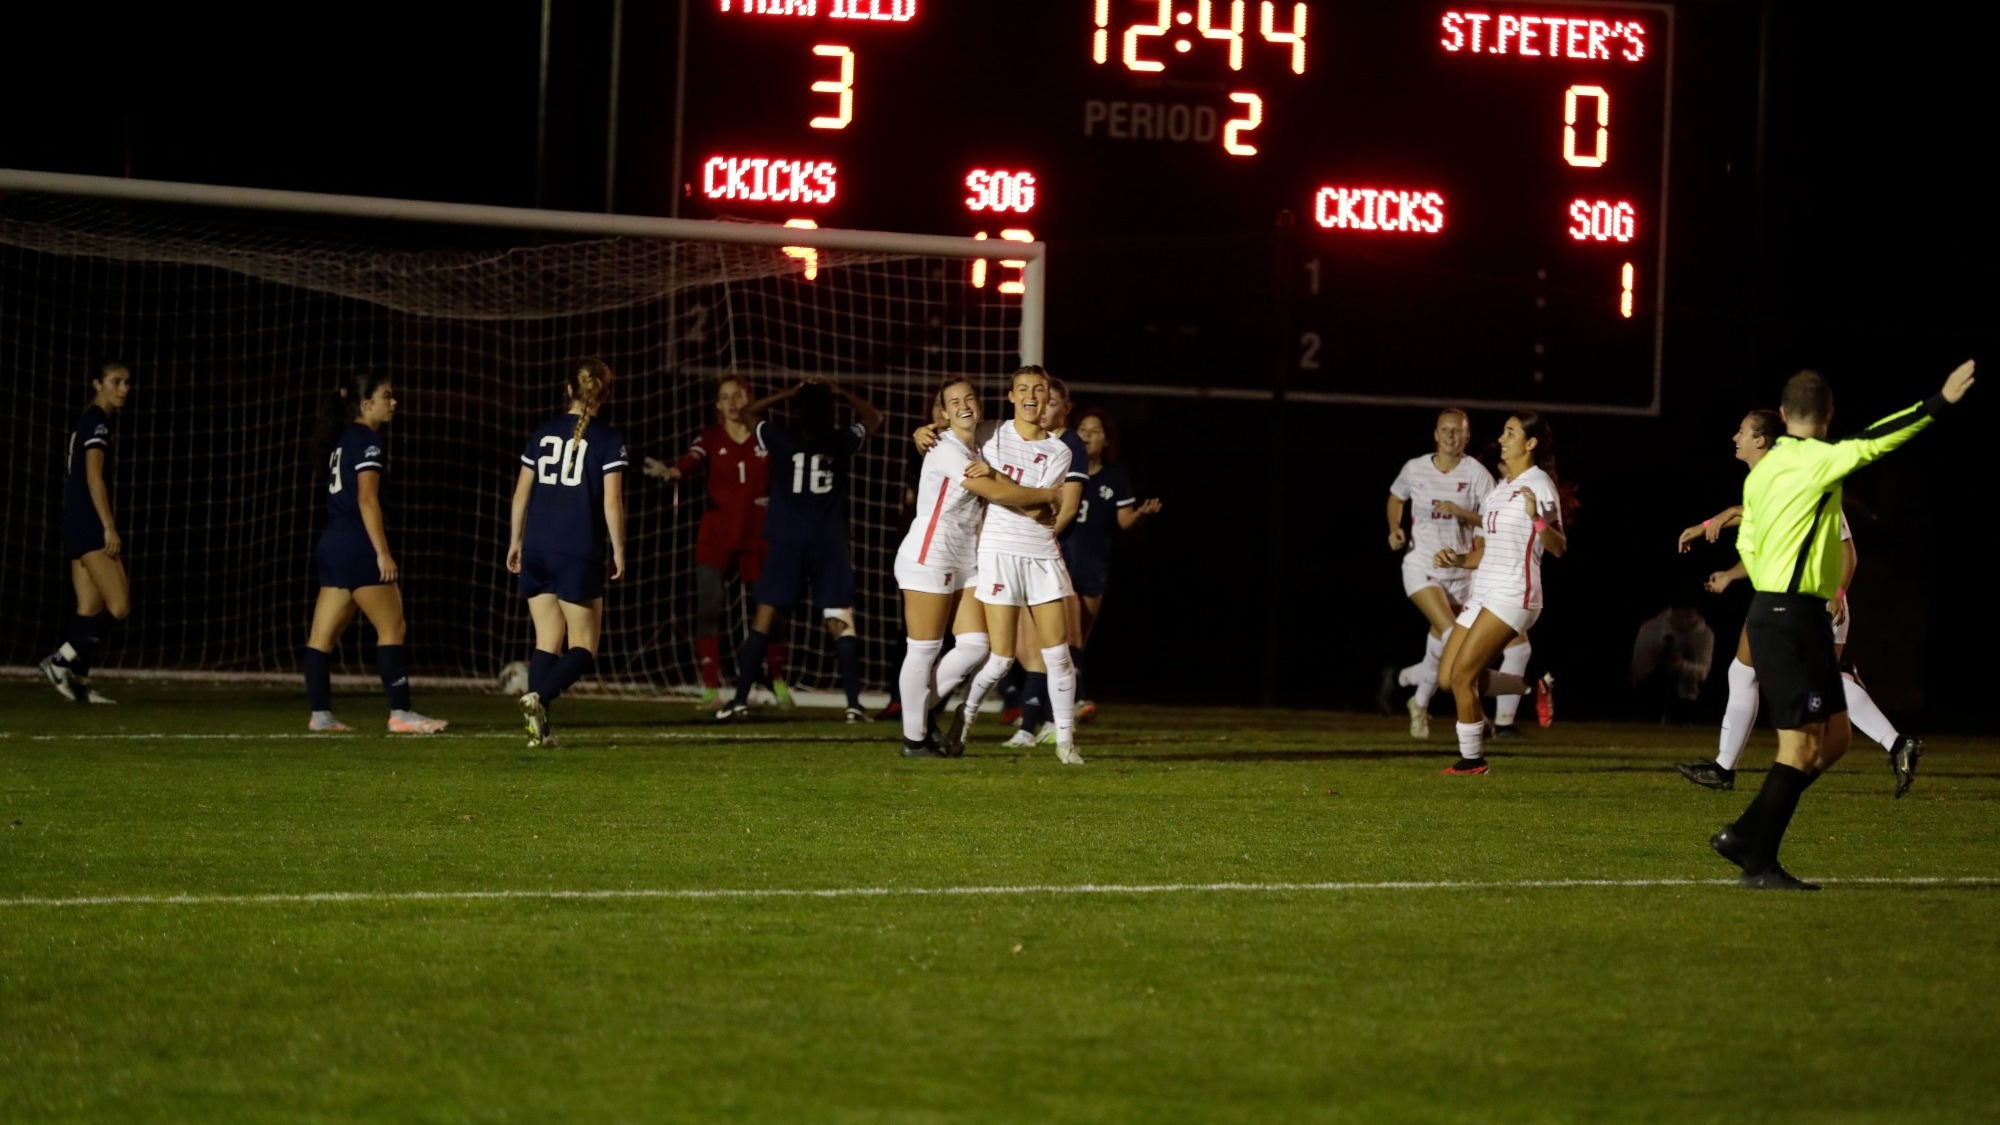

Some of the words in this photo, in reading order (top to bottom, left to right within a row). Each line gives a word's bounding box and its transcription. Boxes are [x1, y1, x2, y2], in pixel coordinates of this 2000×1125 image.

[1093, 0, 1307, 74] 12:44
[1441, 12, 1645, 61] ST.PETER'S
[809, 45, 854, 129] 3
[1084, 101, 1217, 142] PERIOD
[1224, 93, 1262, 156] 2
[1563, 85, 1609, 167] 0
[704, 156, 837, 203] CKICKS
[965, 169, 1035, 212] SOG
[1316, 187, 1443, 233] CKICKS
[1569, 199, 1634, 241] SOG
[1305, 258, 1321, 296] 1
[1621, 262, 1634, 318] 1
[1300, 331, 1321, 370] 2
[537, 435, 589, 486] 20
[738, 461, 746, 484] 1
[792, 452, 834, 494] 16
[1487, 510, 1499, 533] 11
